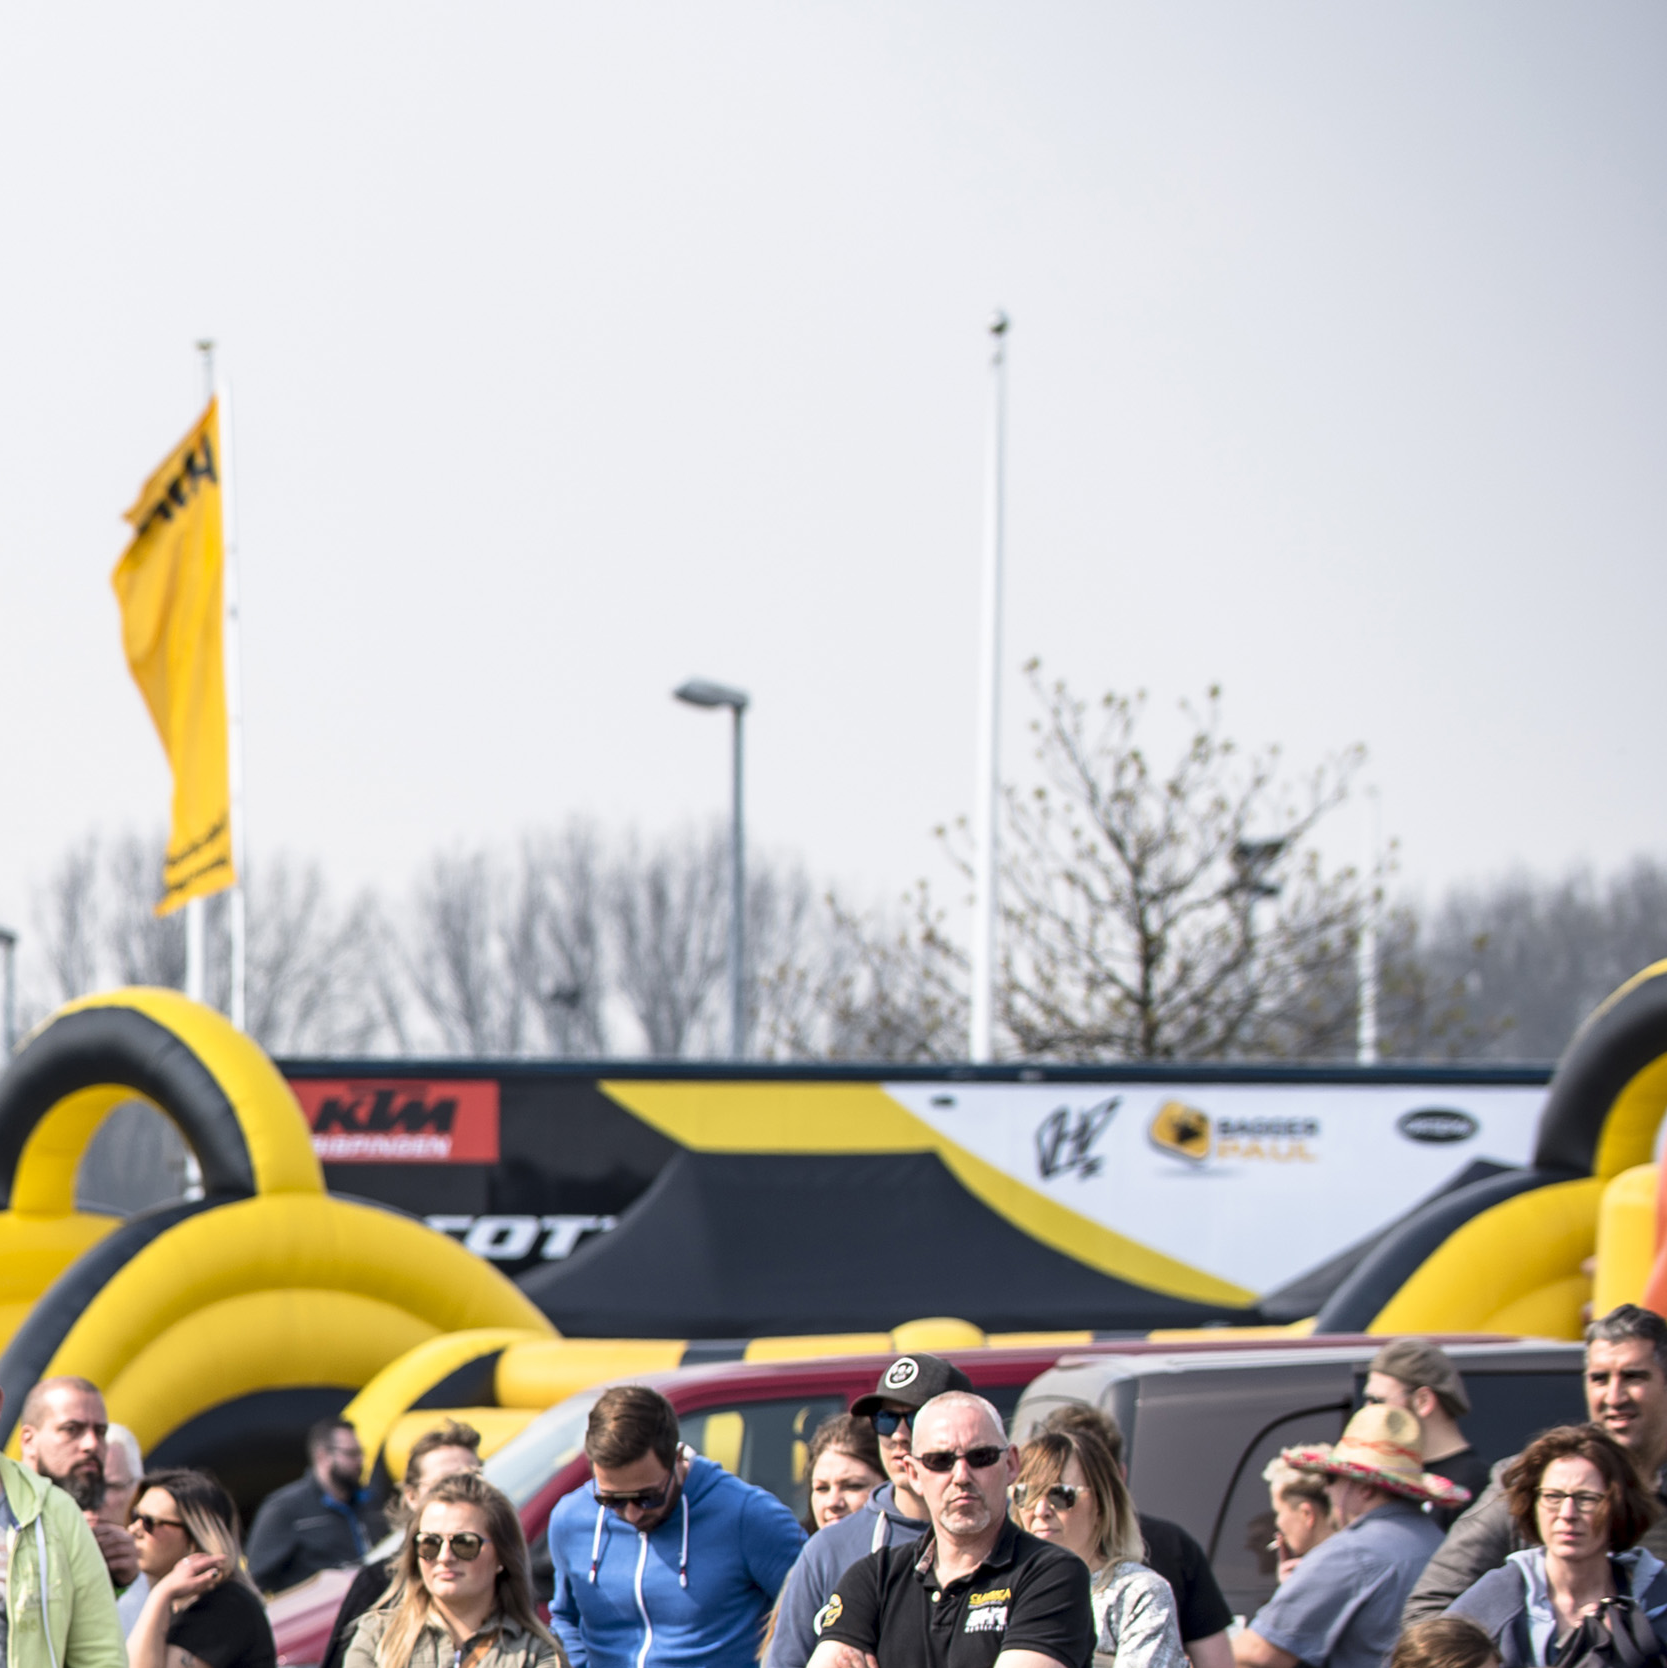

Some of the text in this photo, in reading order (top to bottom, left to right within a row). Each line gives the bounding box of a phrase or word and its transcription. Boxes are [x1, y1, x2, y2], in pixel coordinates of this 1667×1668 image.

[314, 1089, 459, 1132] KTM
[1216, 1142, 1318, 1163] PAUL
[422, 1213, 618, 1261] COT
